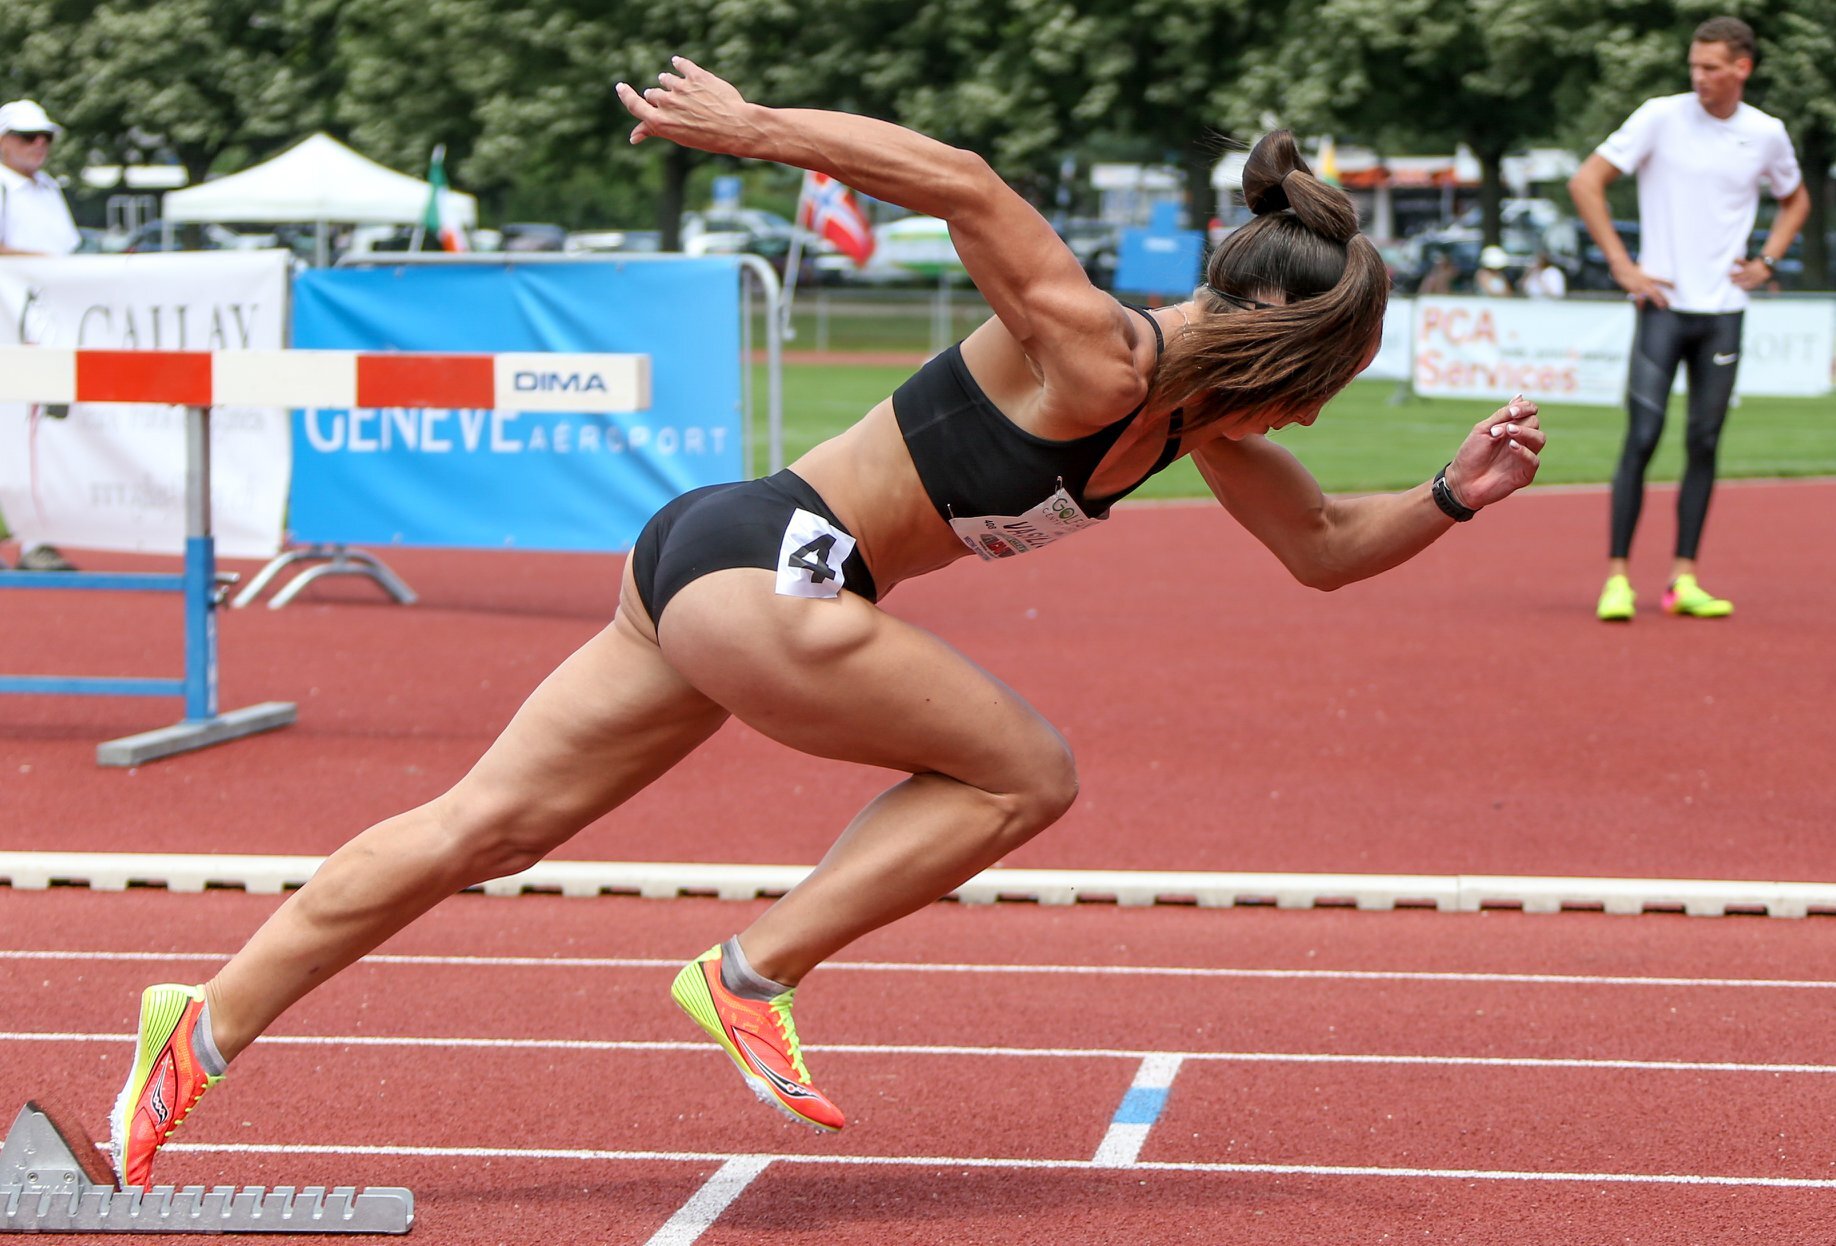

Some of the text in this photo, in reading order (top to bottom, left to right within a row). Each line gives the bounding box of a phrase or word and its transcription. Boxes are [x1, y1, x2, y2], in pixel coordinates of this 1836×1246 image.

[1420, 307, 1498, 345] PCA
[513, 371, 608, 393] DIMA
[1417, 350, 1578, 392] Services
[787, 533, 837, 584] 4
